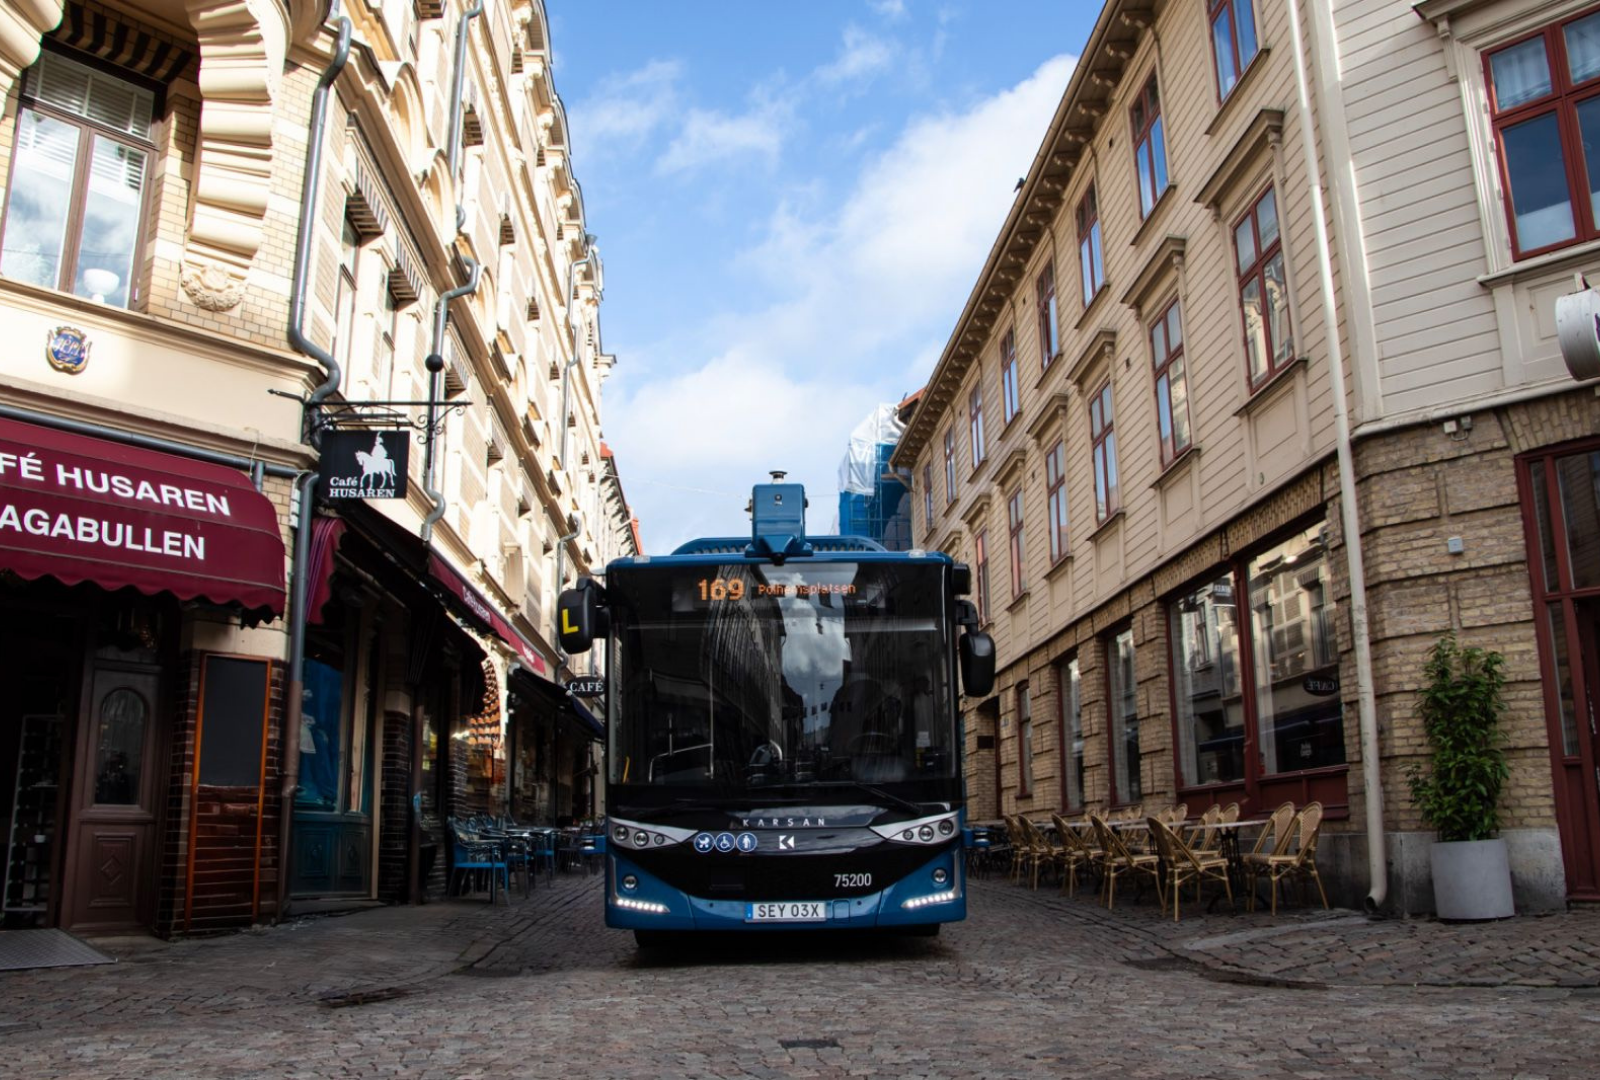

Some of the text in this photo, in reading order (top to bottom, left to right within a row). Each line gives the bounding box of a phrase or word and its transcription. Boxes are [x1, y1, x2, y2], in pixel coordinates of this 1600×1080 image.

[329, 476, 358, 487] Café
[56, 464, 231, 516] HUSAREN
[329, 488, 396, 498] HUSAREN
[698, 578, 745, 600] 169
[569, 679, 604, 692] CAFÉ
[742, 818, 826, 827] KARSAN
[834, 873, 872, 887] 75200
[758, 904, 819, 917] SEY 03X
